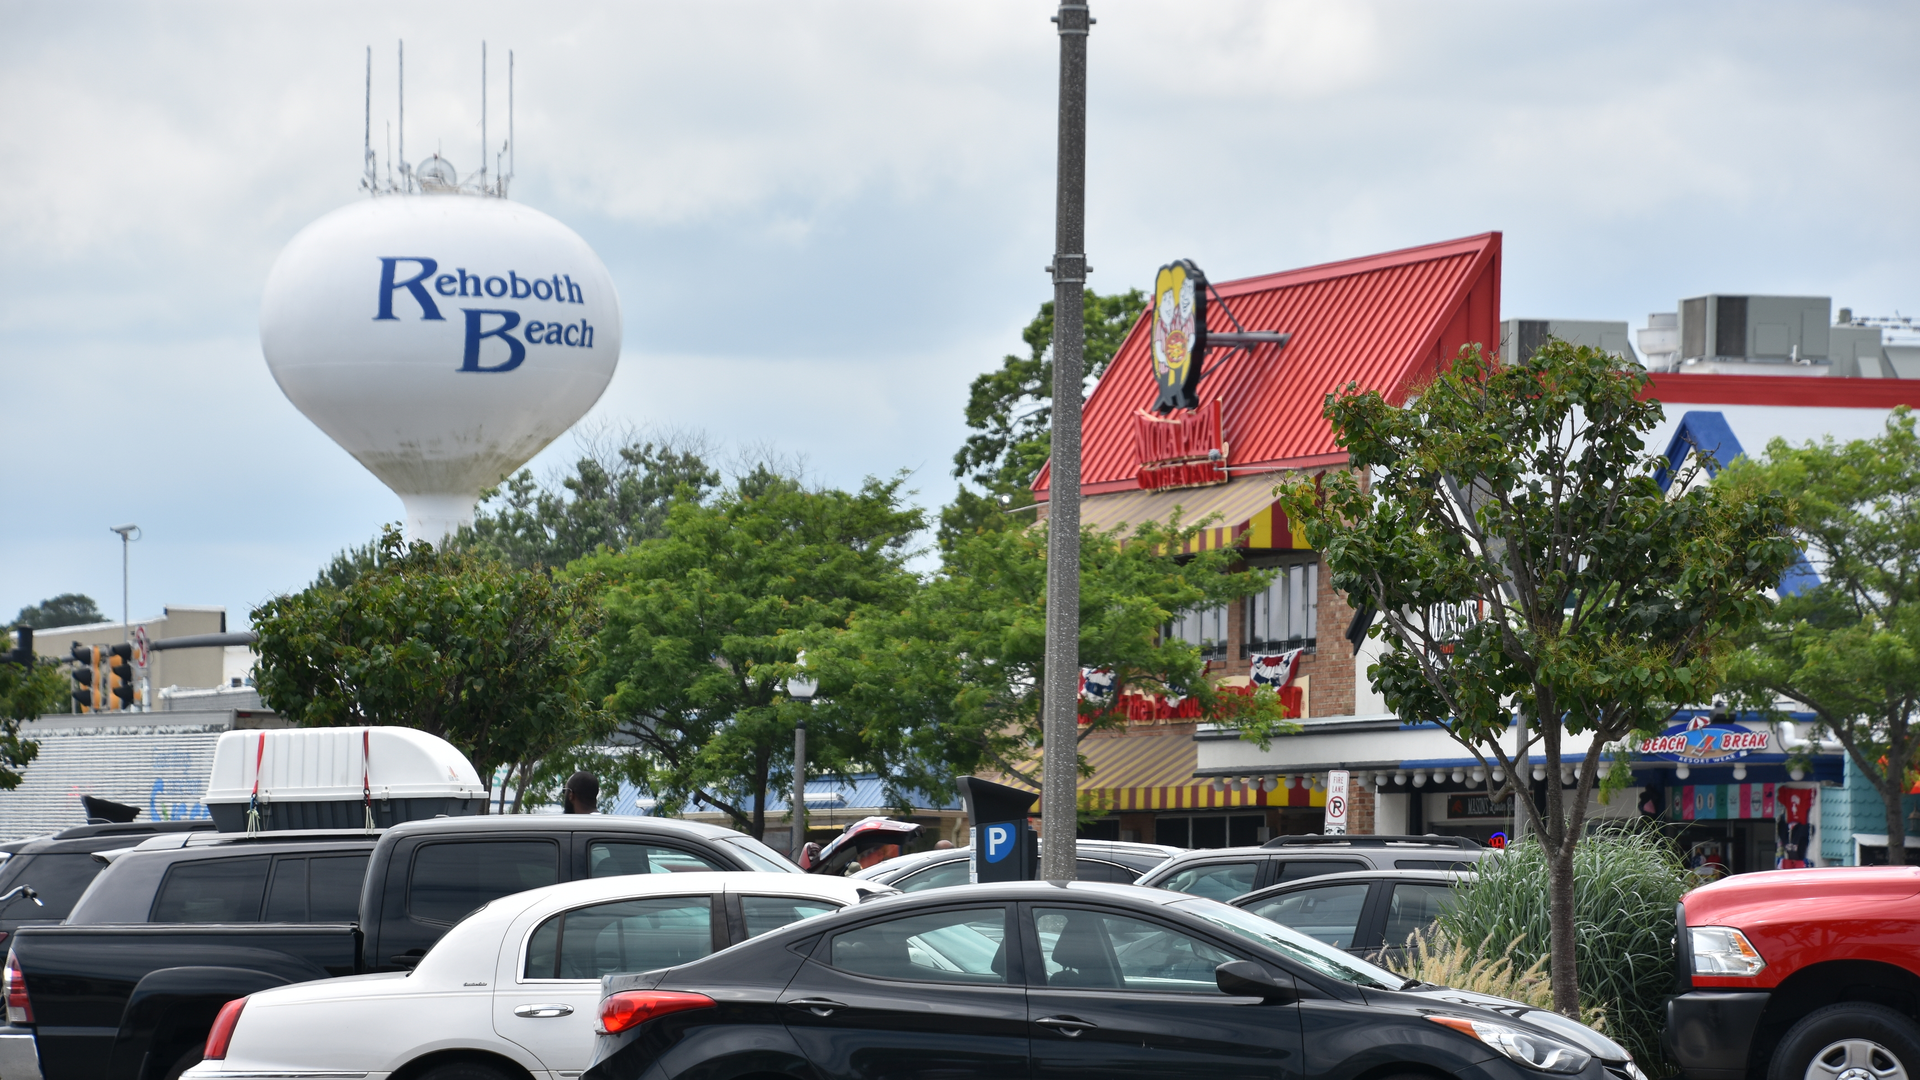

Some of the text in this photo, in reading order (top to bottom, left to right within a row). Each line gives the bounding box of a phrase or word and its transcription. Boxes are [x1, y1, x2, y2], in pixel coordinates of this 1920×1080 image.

[371, 256, 584, 321] Rehoboth
[455, 307, 594, 373] Beach
[1641, 733, 1768, 752] BEACH BREAK
[1713, 754, 1736, 763] WEAR
[1333, 776, 1343, 784] FIRE
[989, 827, 1007, 855] P
